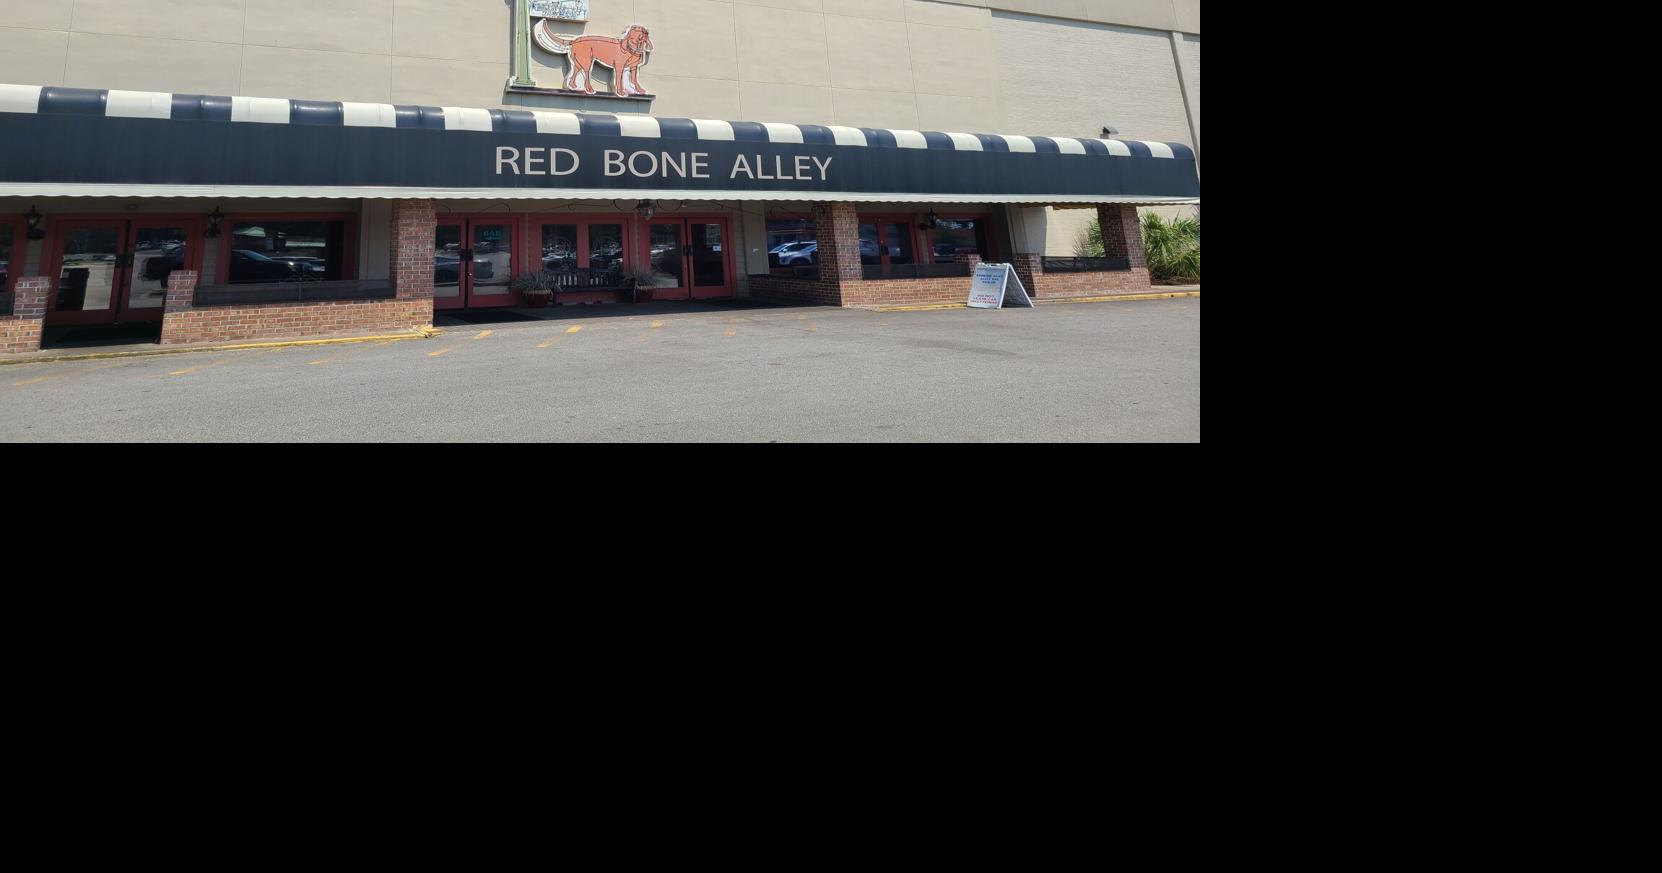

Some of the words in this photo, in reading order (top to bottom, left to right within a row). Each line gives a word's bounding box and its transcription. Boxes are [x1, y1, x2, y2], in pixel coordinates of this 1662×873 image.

[495, 146, 580, 176] RED
[603, 149, 710, 178] BONE
[729, 153, 833, 181] ALLEY
